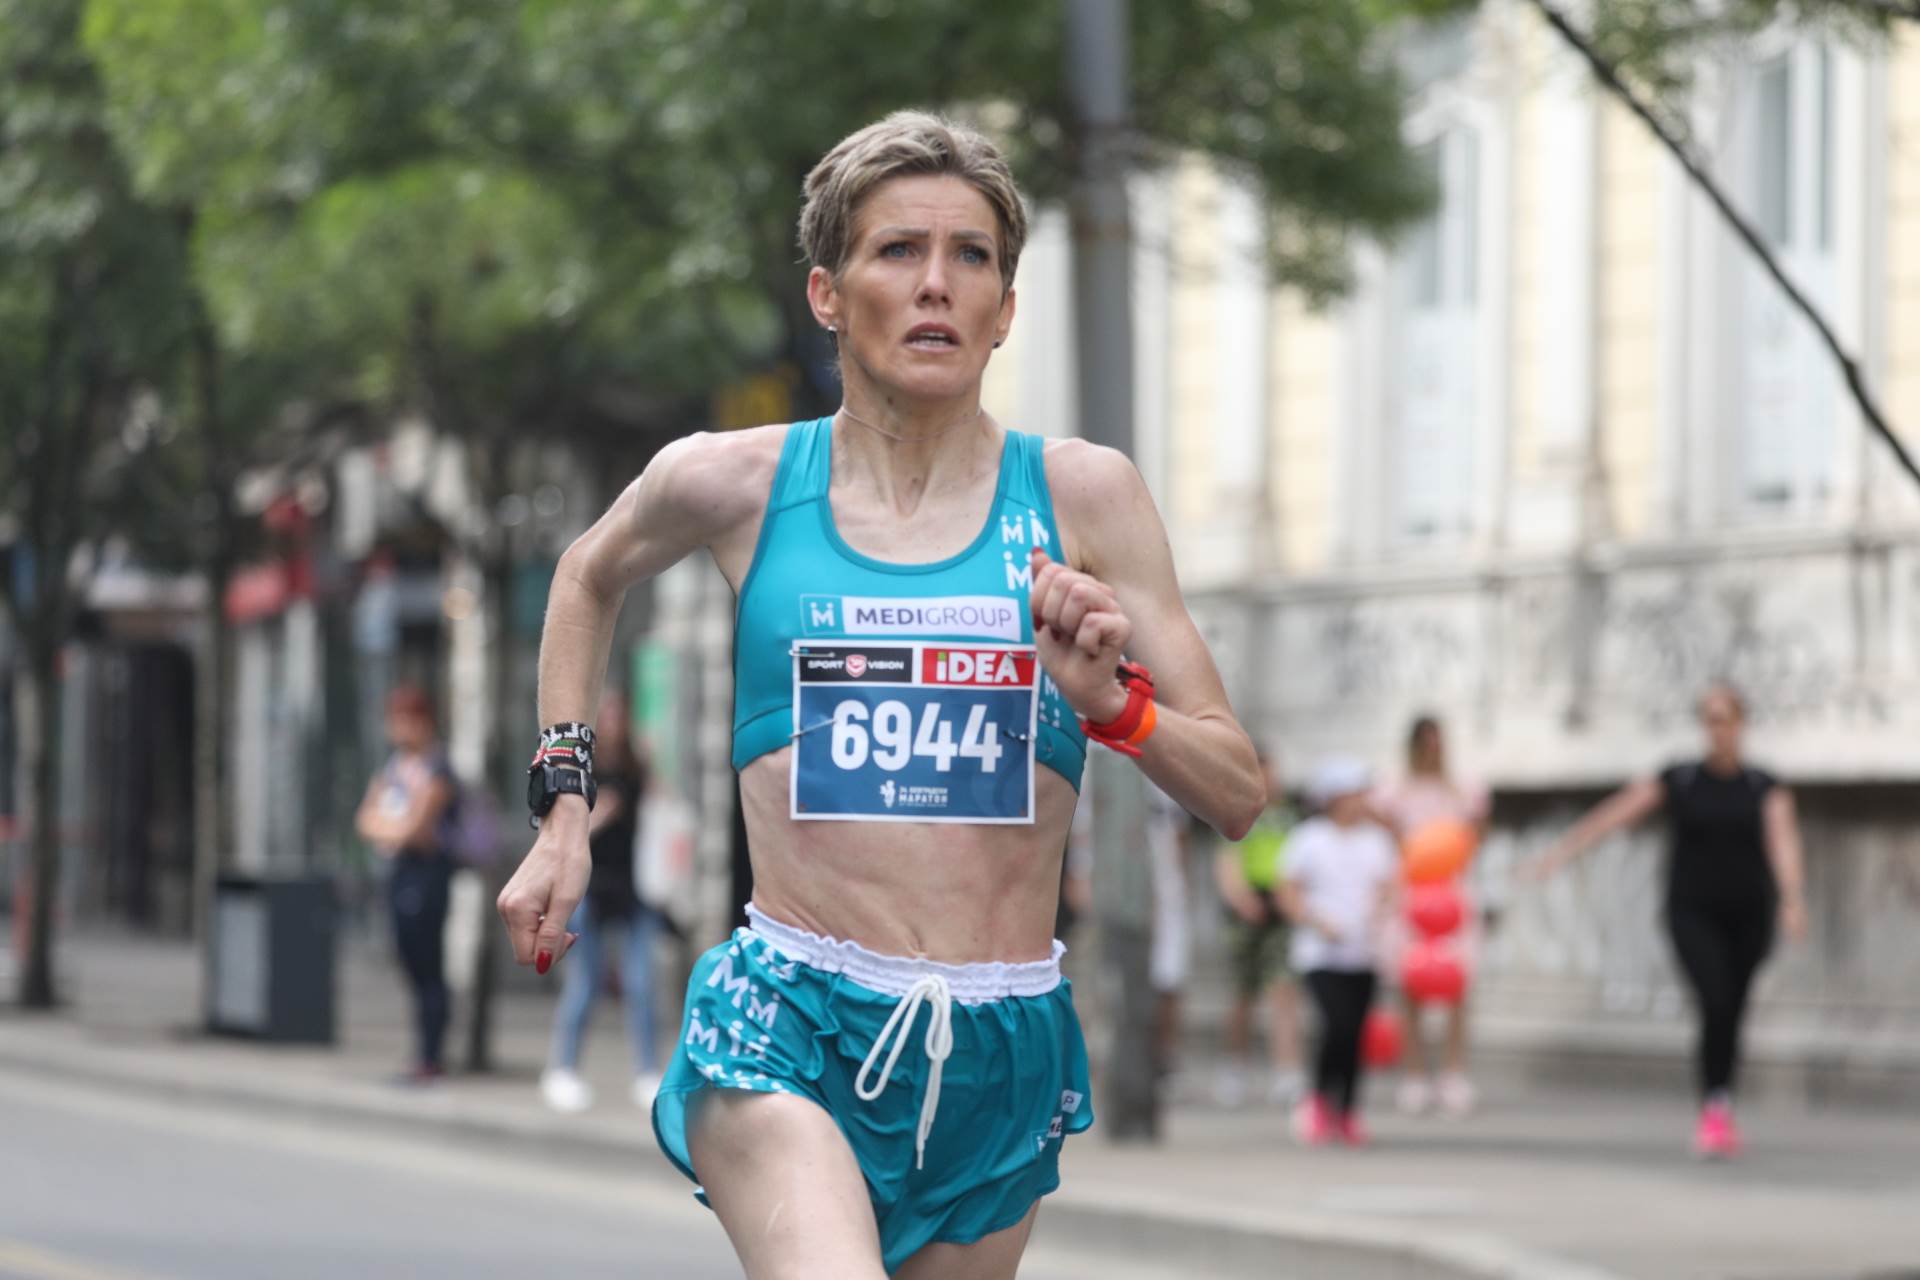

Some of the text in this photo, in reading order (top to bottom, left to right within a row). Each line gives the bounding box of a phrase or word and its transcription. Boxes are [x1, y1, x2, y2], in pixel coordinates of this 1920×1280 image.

[855, 606, 1012, 628] MEDIGROUP
[807, 660, 905, 670] SPORT VISION
[831, 699, 1003, 773] 6944
